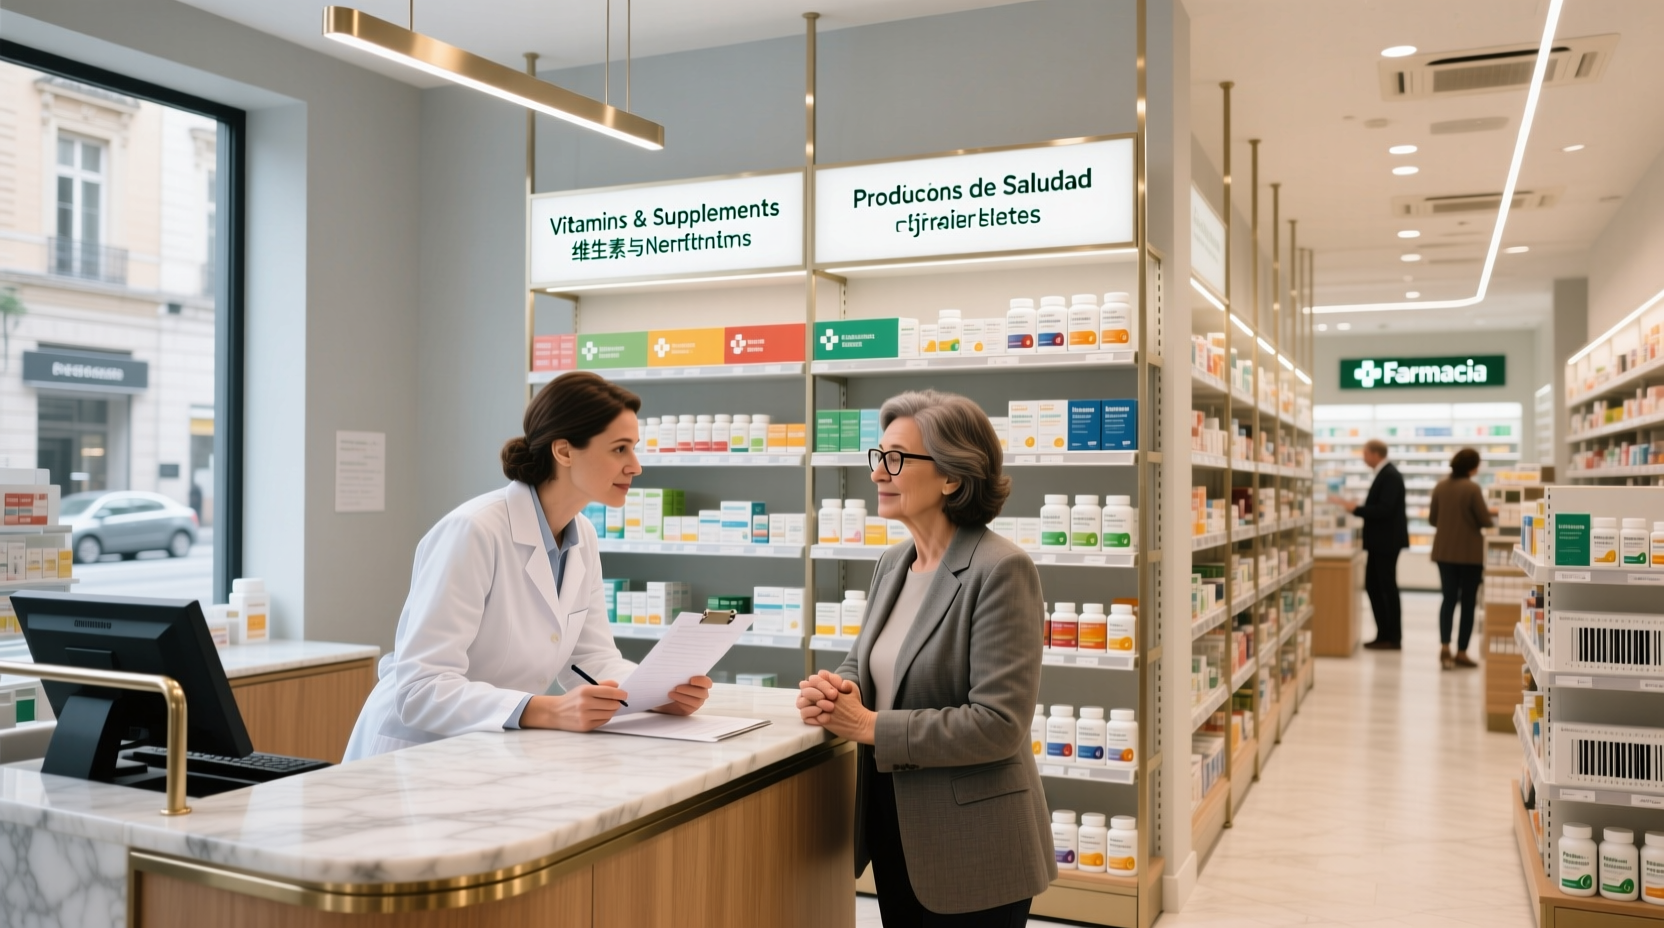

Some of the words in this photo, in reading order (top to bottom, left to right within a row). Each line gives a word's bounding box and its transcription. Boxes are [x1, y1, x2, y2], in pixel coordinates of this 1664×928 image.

[969, 177, 997, 199] de
[1003, 167, 1092, 196] Saludad
[549, 211, 628, 236] Vitamins
[633, 209, 647, 228] &
[653, 198, 780, 229] Supplements
[1383, 359, 1488, 384] Farmacia
